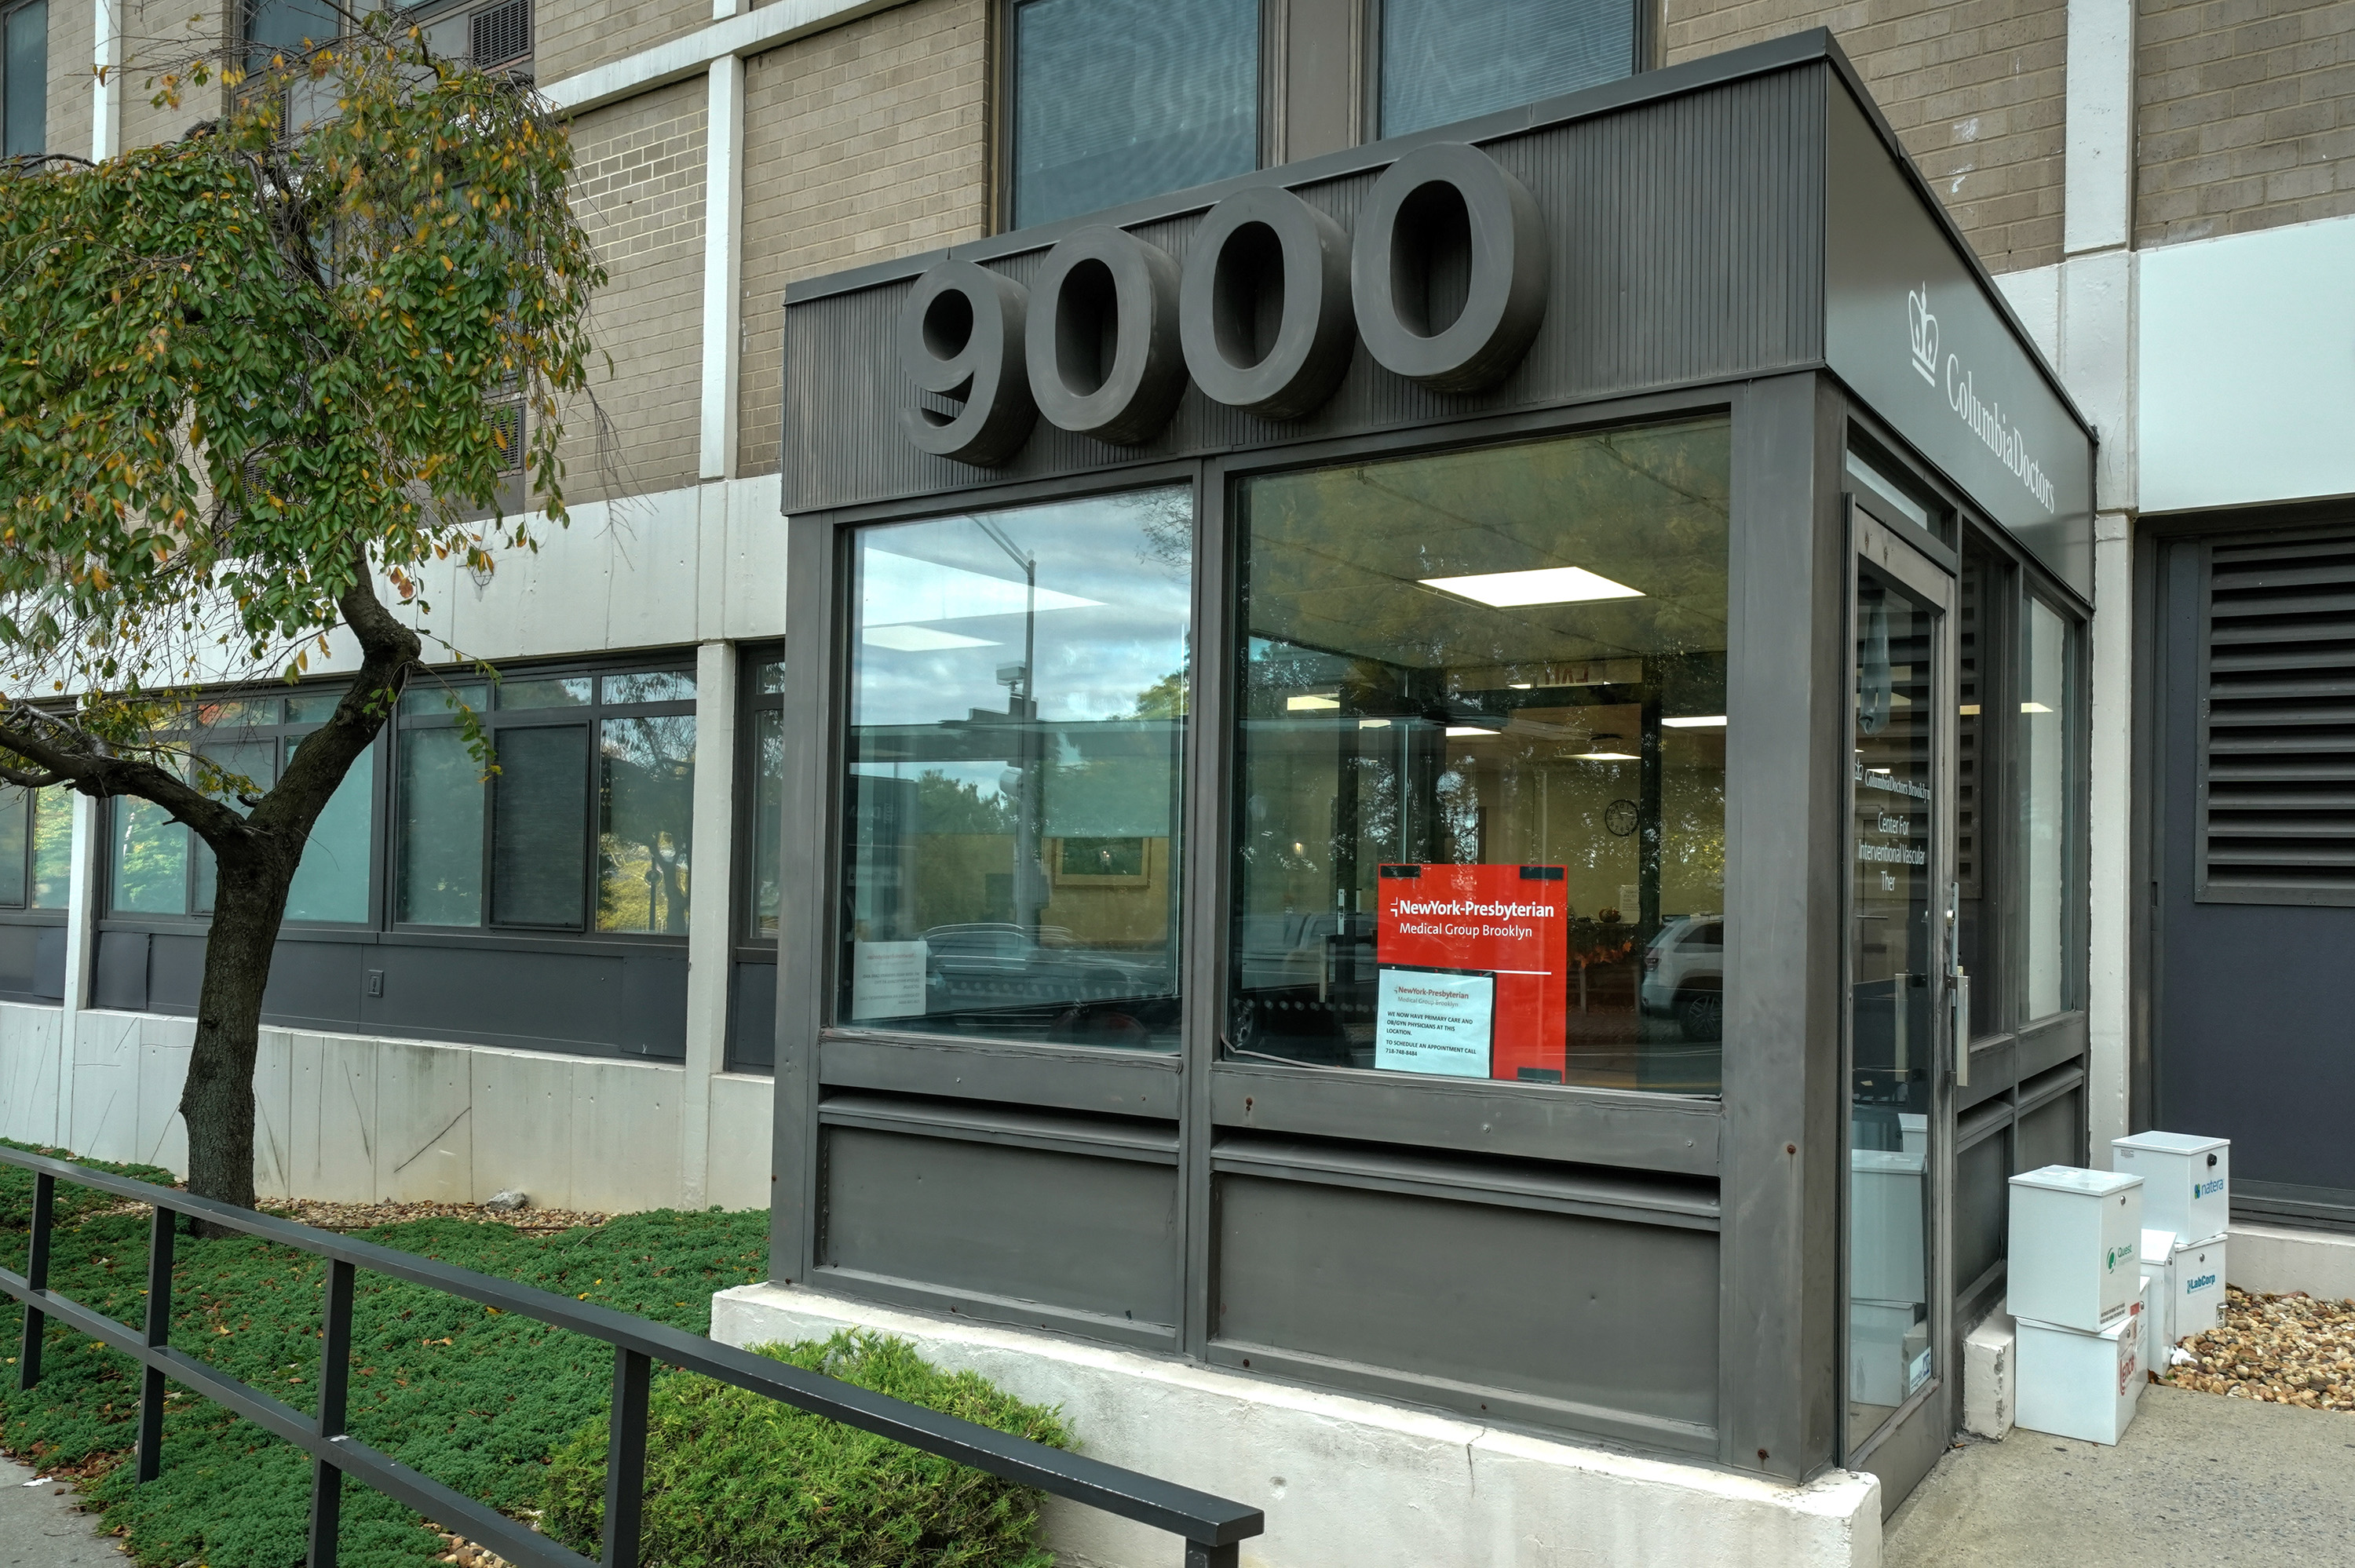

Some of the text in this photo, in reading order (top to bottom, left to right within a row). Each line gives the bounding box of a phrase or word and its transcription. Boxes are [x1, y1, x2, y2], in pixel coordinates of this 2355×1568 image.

[897, 141, 1549, 466] 9000
[1947, 353, 2055, 514] ColumbiaDoctors
[1865, 769, 1930, 804] ColumbiaDoctors Brooklyn
[1878, 811, 1909, 835] Center For
[1859, 839, 1925, 865] Interventional Vascular
[1881, 870, 1895, 891] Ther
[1400, 900, 1554, 921] NewYork-Presbyterian
[1400, 923, 1532, 940] Medical Group Brooklyn
[1398, 986, 1469, 999] NewYork-Presbyterian
[1427, 1044, 1463, 1053] APPOINTMENT
[2201, 1179, 2223, 1195] natera
[2118, 1243, 2132, 1257] Quest
[2190, 1274, 2215, 1289] LabCorp
